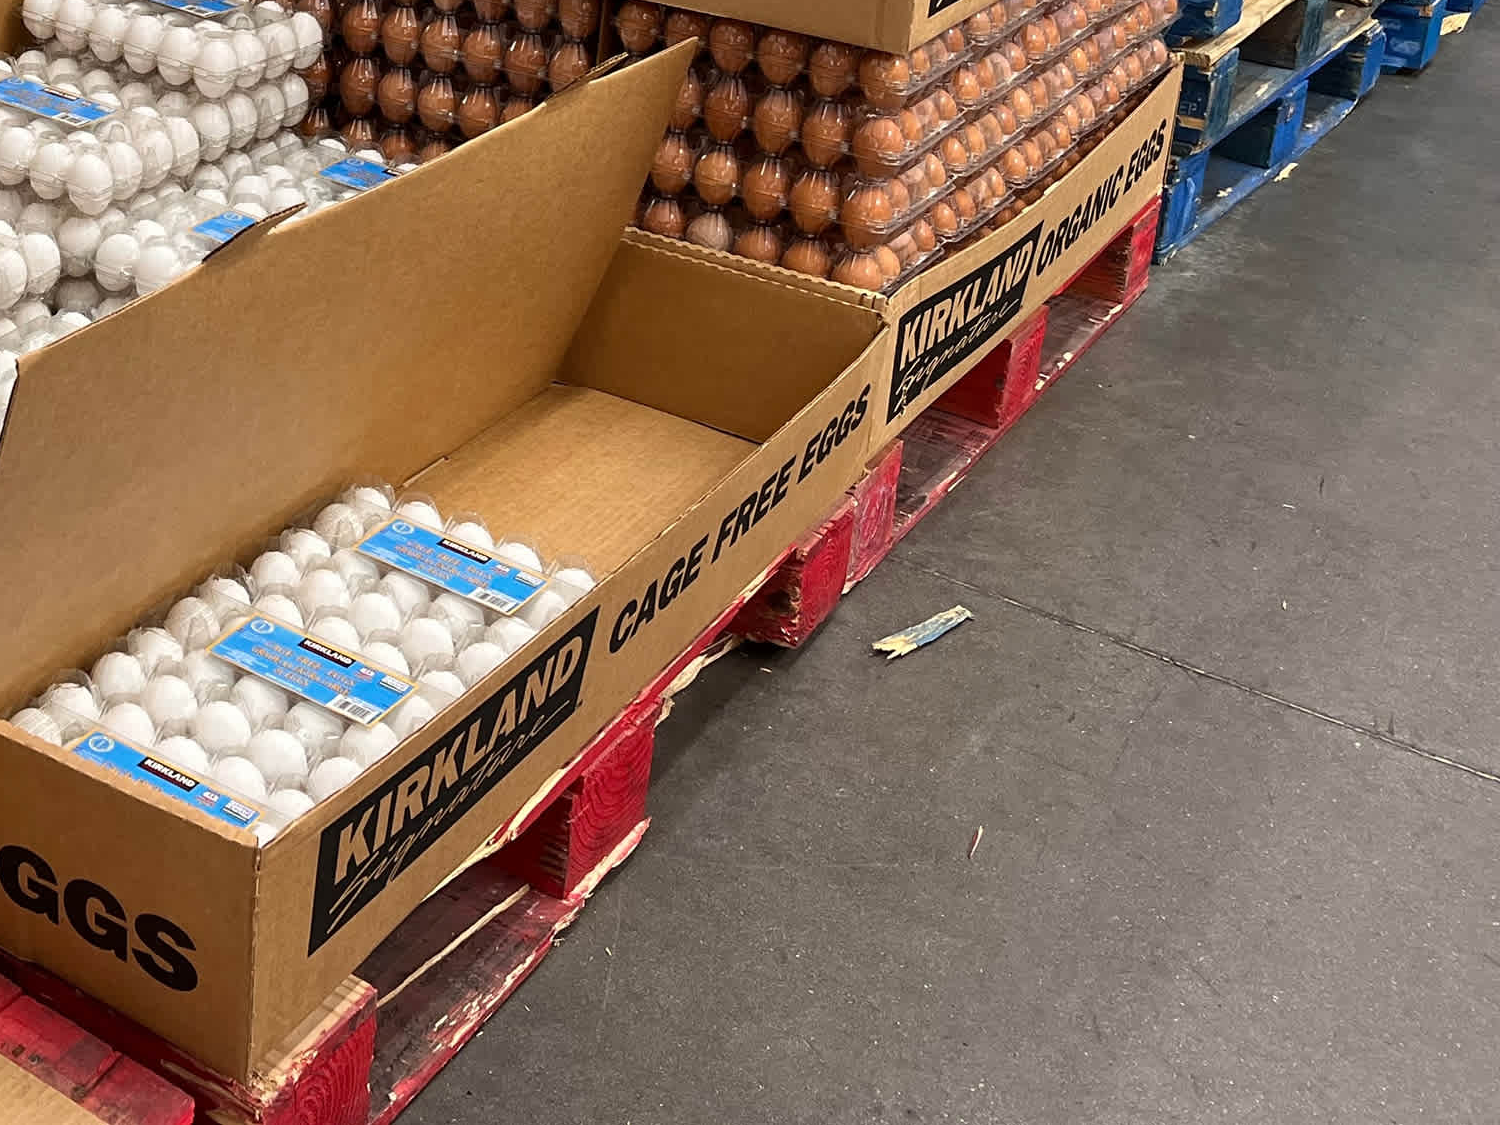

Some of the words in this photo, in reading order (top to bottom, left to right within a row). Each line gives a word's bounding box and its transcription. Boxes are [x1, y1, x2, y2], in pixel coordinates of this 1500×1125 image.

[1035, 177, 1124, 277] ORGANIC
[1122, 118, 1167, 204] EGGS
[893, 297, 1017, 413] Signature
[899, 237, 1036, 371] KIRKLAND
[608, 533, 710, 654] CAGE
[709, 455, 795, 565] FREE
[796, 383, 873, 485] EGGS
[303, 639, 354, 666] KIRKLAND
[143, 758, 197, 789] KIRKLAND
[325, 697, 572, 931] Signature
[332, 627, 585, 887] KIRKLAND
